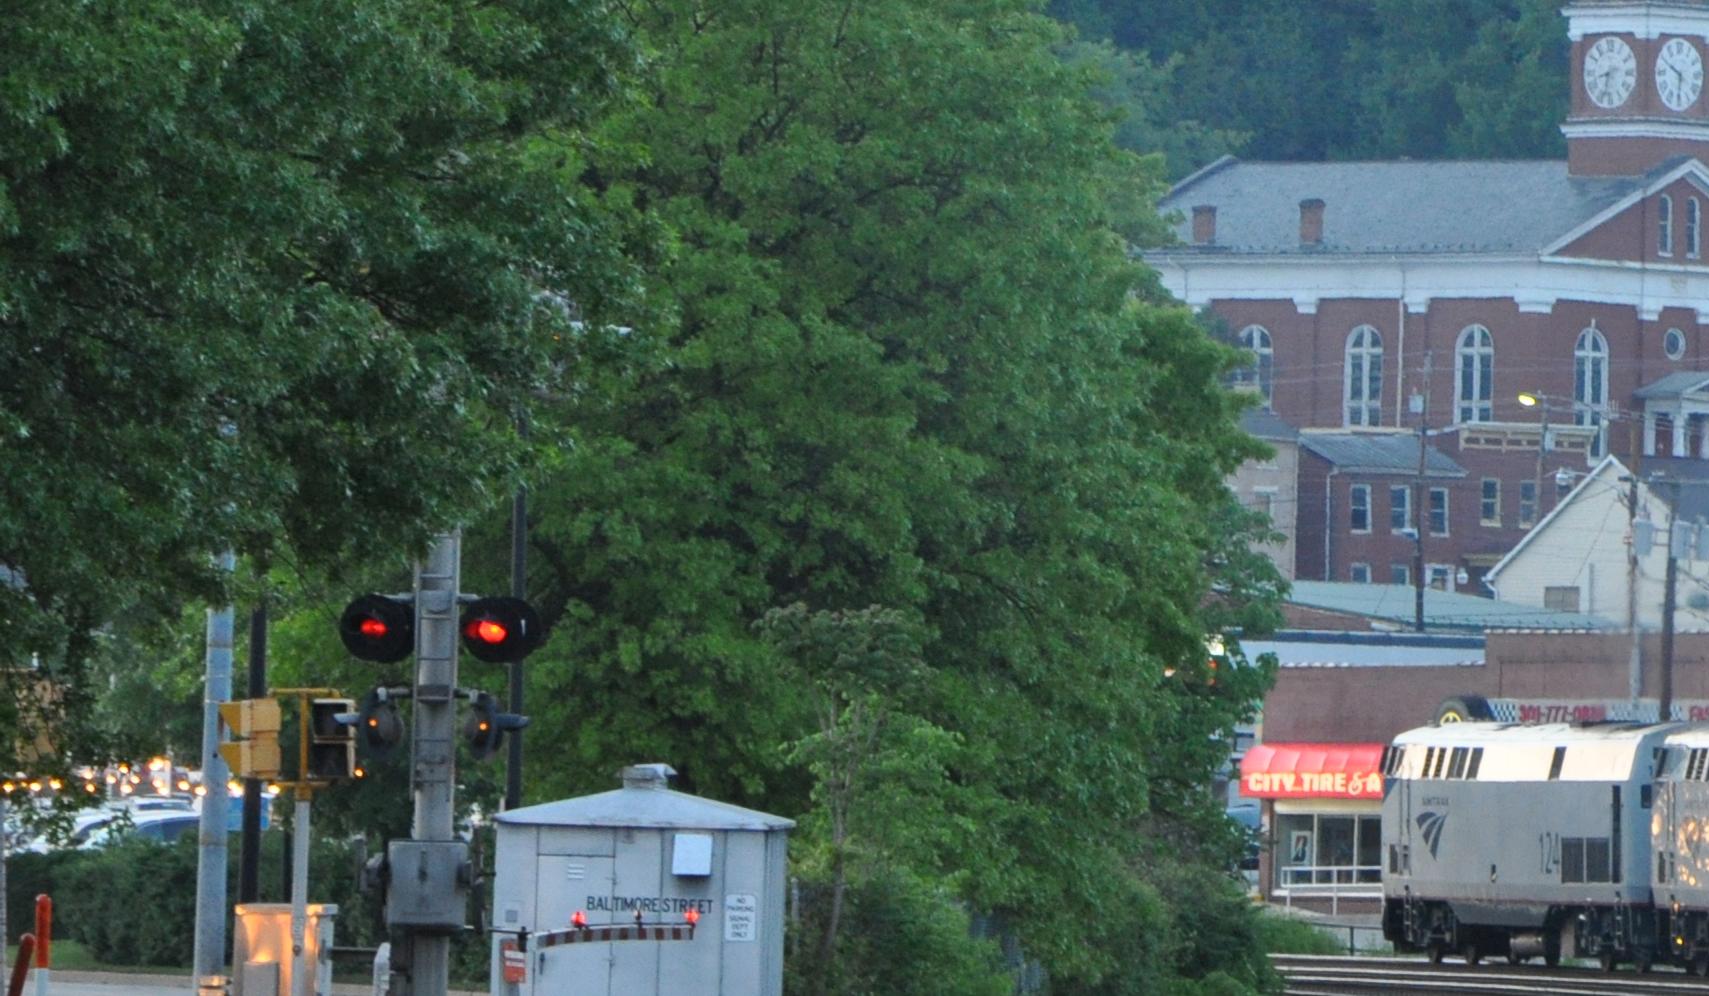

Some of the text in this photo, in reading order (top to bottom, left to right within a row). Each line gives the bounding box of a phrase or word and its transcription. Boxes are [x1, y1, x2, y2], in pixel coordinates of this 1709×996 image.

[1248, 772, 1296, 792] CITY
[1301, 773, 1346, 792] TIRE
[1347, 772, 1367, 795] &
[1539, 832, 1561, 874] 124
[586, 896, 713, 914] BALTIMORE STREET
